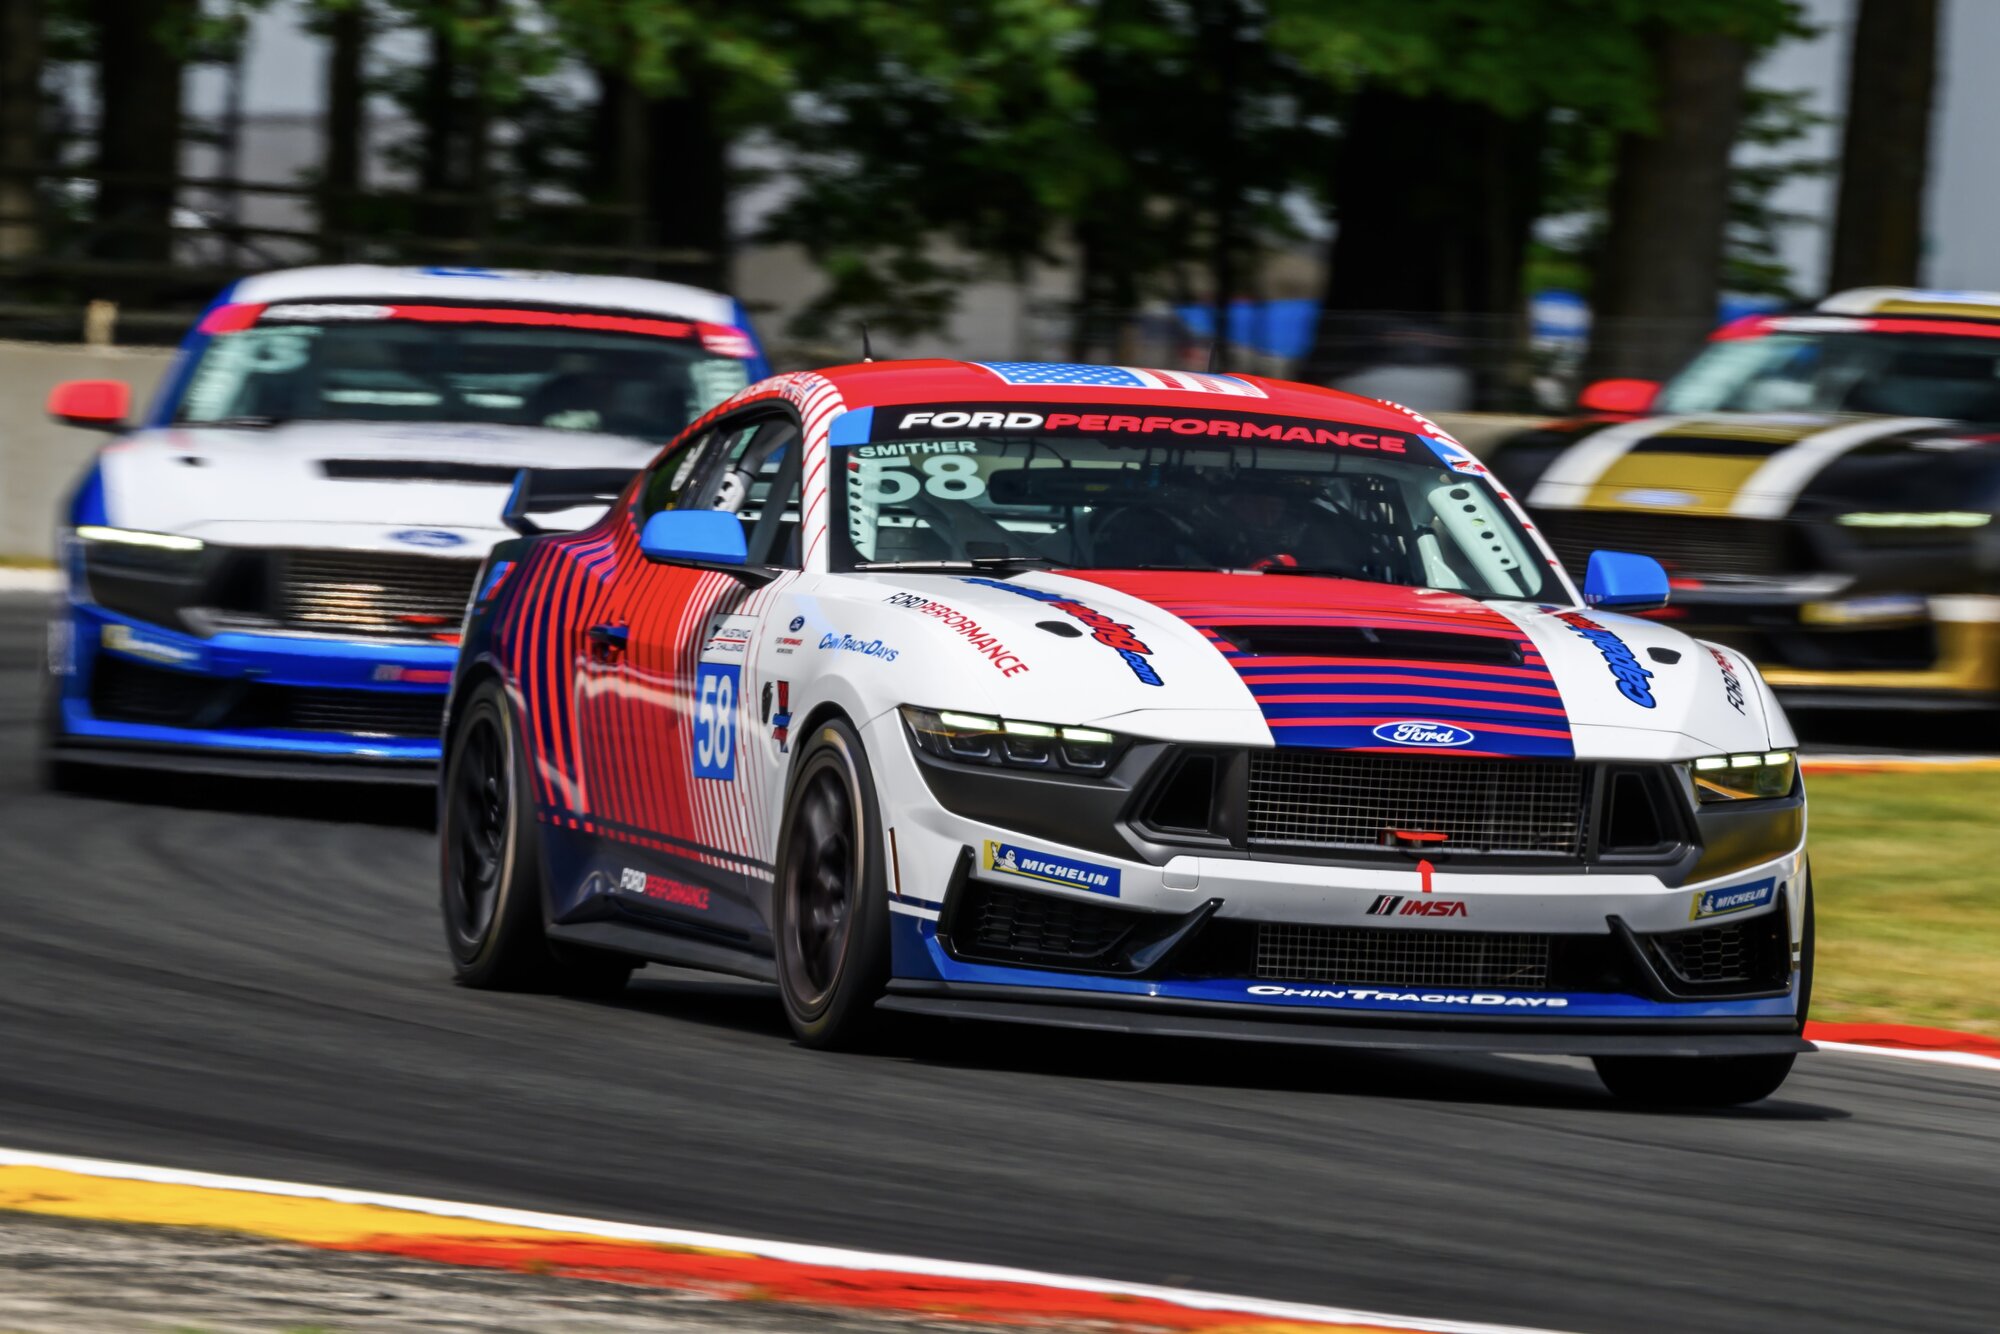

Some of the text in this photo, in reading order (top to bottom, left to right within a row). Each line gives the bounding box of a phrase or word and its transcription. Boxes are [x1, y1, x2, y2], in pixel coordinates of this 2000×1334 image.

[899, 412, 1406, 453] FORD PERFORMANCE
[859, 441, 978, 457] SMITHER
[863, 454, 986, 503] 58
[920, 602, 1029, 678] PERFORMANCE
[698, 674, 732, 769] 58
[1393, 724, 1454, 743] Ford
[1020, 858, 1109, 886] MICHELIN
[1398, 900, 1468, 917] IMSA
[1715, 887, 1768, 909] MICHELIN
